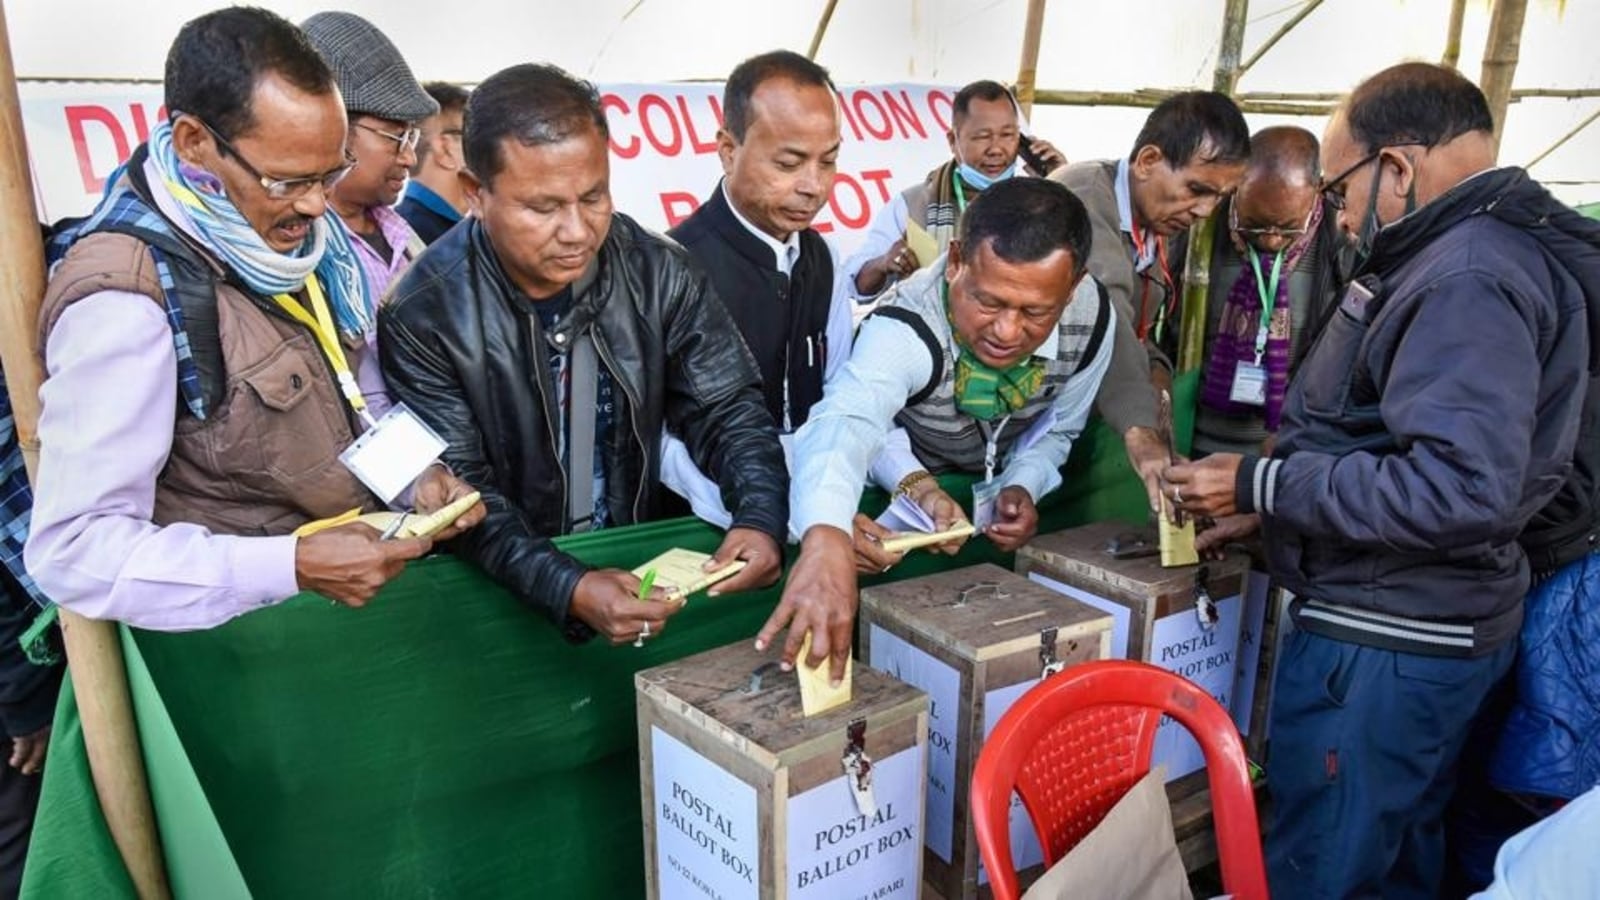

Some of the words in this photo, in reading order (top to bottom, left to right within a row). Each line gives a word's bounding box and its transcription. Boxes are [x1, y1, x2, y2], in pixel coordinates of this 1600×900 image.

[1162, 632, 1216, 662] POSTAL
[1206, 651, 1231, 670] BOX
[928, 727, 951, 755] OX
[673, 782, 737, 842] POSTAL
[815, 803, 897, 851] POSTAL
[662, 803, 718, 855] BALLOT
[721, 847, 753, 884] BOX
[797, 842, 874, 890] BALLOT
[878, 824, 915, 854] BOX
